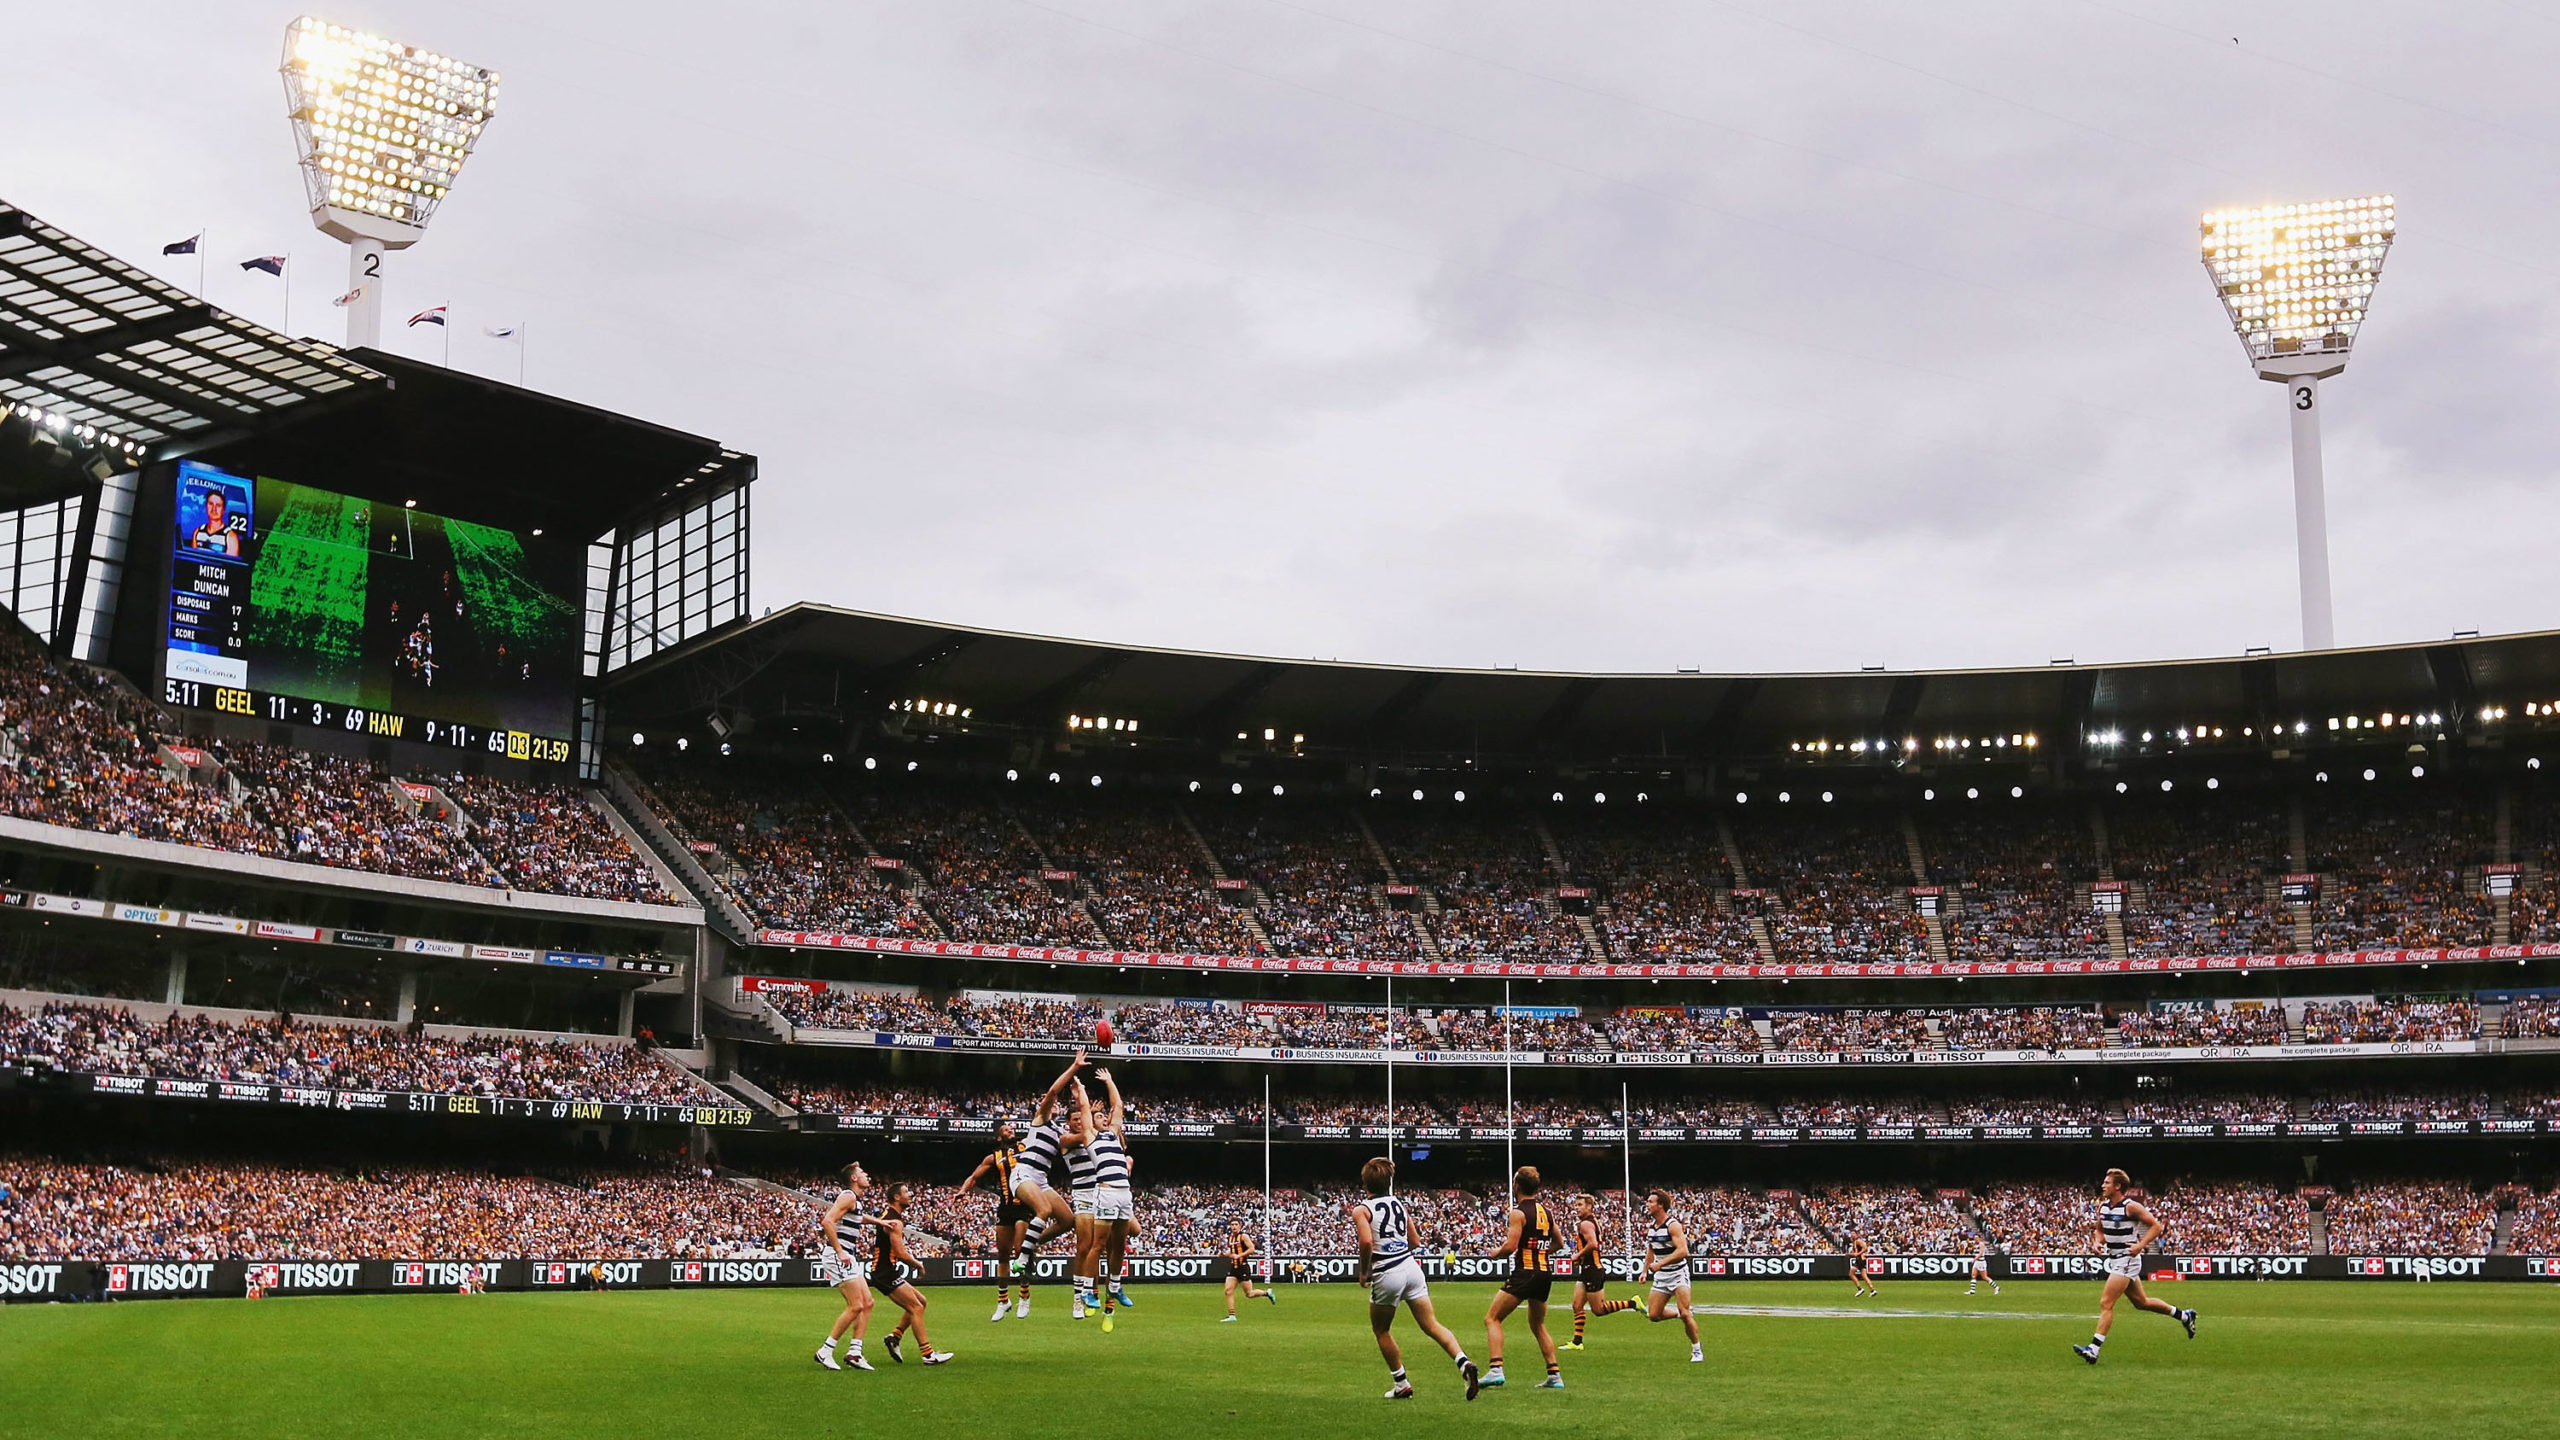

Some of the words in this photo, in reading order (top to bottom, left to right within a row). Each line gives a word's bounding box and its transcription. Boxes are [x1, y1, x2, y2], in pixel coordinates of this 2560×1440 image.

[363, 252, 381, 279] 2
[2295, 386, 2313, 411] 3
[230, 515, 247, 531] 22
[199, 564, 226, 580] MITCH
[194, 580, 230, 597] DUNCAN
[177, 595, 211, 610] DISPOSALS
[231, 605, 243, 616] 17
[176, 612, 198, 624] MARKS
[232, 621, 239, 632] 3
[175, 628, 196, 640] SCORE
[227, 636, 242, 648] 0.0
[165, 679, 199, 707] 5:11
[215, 688, 256, 716] GEEL
[268, 695, 286, 720] 11
[312, 703, 323, 726] 3
[345, 708, 364, 731] 69
[368, 711, 404, 737] HAW
[426, 721, 435, 742] 9
[450, 724, 465, 747] 11
[488, 732, 505, 753] 65
[509, 733, 529, 757] Q3
[532, 738, 569, 762] 21:59
[124, 908, 158, 922] OPTUS
[261, 924, 295, 935] Westpac
[767, 929, 796, 944] Coca-Cola
[841, 934, 869, 949] Coca-Cola
[427, 943, 454, 953] ZURICH
[910, 940, 938, 954] Coca-Cola
[982, 944, 1009, 958] Coca-Cola
[2447, 945, 2480, 960] Coca-Cola
[1052, 948, 1078, 963] Coca-Cola
[1122, 951, 1150, 965] Coca-Cola
[1192, 954, 1220, 968] Coca-Cola
[2207, 954, 2238, 968] Coca-Cola
[2285, 952, 2316, 966] Coca-Cola
[2366, 949, 2397, 963] Coca-Cola
[1262, 956, 1290, 970] Coca-Cola
[1332, 958, 1360, 972] Coca-Cola
[1402, 961, 1430, 975] Coca-Cola
[1473, 962, 1501, 975] Coca-Cola
[1544, 963, 1572, 976] Coca-Cola
[1615, 963, 1643, 976] Coca-Cola
[1686, 963, 1715, 976] Coca-Cola
[1759, 963, 1788, 976] Coca-Cola
[1831, 963, 1860, 976] Coca-Cola
[1904, 962, 1933, 975] Coca-Cola
[1978, 961, 2008, 974] Coca-Cola
[2053, 959, 2083, 973] Coca-Cola
[2130, 957, 2160, 971] Coca-Cola
[1866, 1009, 1891, 1017] Audi
[1928, 1008, 1954, 1016] Audi
[1993, 1007, 2017, 1015] Audi
[2056, 1006, 2081, 1014] Audi
[2160, 1001, 2204, 1013] TOLL
[901, 1034, 935, 1046] PORTER
[952, 1038, 979, 1047] REPORT
[980, 1039, 1019, 1049] ANTISOCIAL
[1020, 1041, 1057, 1050] BEHAVIOUR
[1058, 1043, 1071, 1051] TXT
[1127, 1044, 1150, 1055] GIO
[1153, 1046, 1190, 1056] BUSINESS
[1192, 1047, 1239, 1057] INSURANCE
[1271, 1048, 1293, 1059] GIO
[1296, 1050, 1334, 1059] BUSINESS
[1335, 1050, 1383, 1060] INSURANCE
[1415, 1051, 1437, 1062] GIO
[1440, 1053, 1478, 1062] BUSINESS
[1788, 1052, 1834, 1062] TISSOT
[1863, 1052, 1910, 1062] TISSOT
[1938, 1052, 1985, 1061] TISSOT
[2109, 1050, 2141, 1060] complete
[2142, 1049, 2172, 1059] package
[2280, 1047, 2293, 1055] The
[2295, 1046, 2327, 1056] complete
[2329, 1045, 2360, 1056] package
[1566, 1053, 1612, 1063] TISSOT
[1639, 1053, 1686, 1063] TISSOT
[1713, 1053, 1759, 1063] TISSOT
[109, 1076, 145, 1090] TISSOT
[232, 1084, 270, 1098] TISSOT
[351, 1092, 387, 1104] TISSOT
[408, 1094, 435, 1112] 5:11
[448, 1096, 481, 1115] GEEL
[491, 1098, 504, 1116] 11
[525, 1100, 533, 1116] 3
[551, 1102, 568, 1118] 69
[572, 1103, 603, 1120] HAW
[623, 1104, 631, 1120] 9
[645, 1105, 659, 1121] 11
[679, 1107, 694, 1123] 65
[719, 1108, 752, 1125] 21:59
[850, 1117, 884, 1126] TISSOT
[961, 1119, 994, 1128] TISSOT
[2240, 1124, 2276, 1132] TISSOT
[2366, 1122, 2403, 1131] TISSOT
[2496, 1120, 2534, 1129] TISSOT
[1181, 1125, 1214, 1133] TISSOT
[1317, 1127, 1350, 1135] TISSOT
[1428, 1128, 1460, 1137] TISSOT
[1539, 1129, 1572, 1137] TISSOT
[1652, 1129, 1685, 1137] TISSOT
[1765, 1129, 1798, 1137] TISSOT
[1880, 1128, 1914, 1137] TISSOT
[1997, 1127, 2032, 1136] TISSOT
[2116, 1126, 2152, 1134] TISSOT
[1374, 1200, 1407, 1239] 28
[1535, 1202, 1550, 1237] 4
[1387, 1241, 1407, 1252] Ford
[703, 1262, 782, 1282] TISSOT
[1130, 1259, 1211, 1276] TISSOT
[1728, 1258, 1815, 1275] TISSOT
[1884, 1258, 1973, 1275] TISSOT
[2385, 1257, 2483, 1275] TISSOT
[128, 1264, 214, 1290] TISSOT
[280, 1263, 360, 1288] TISSOT
